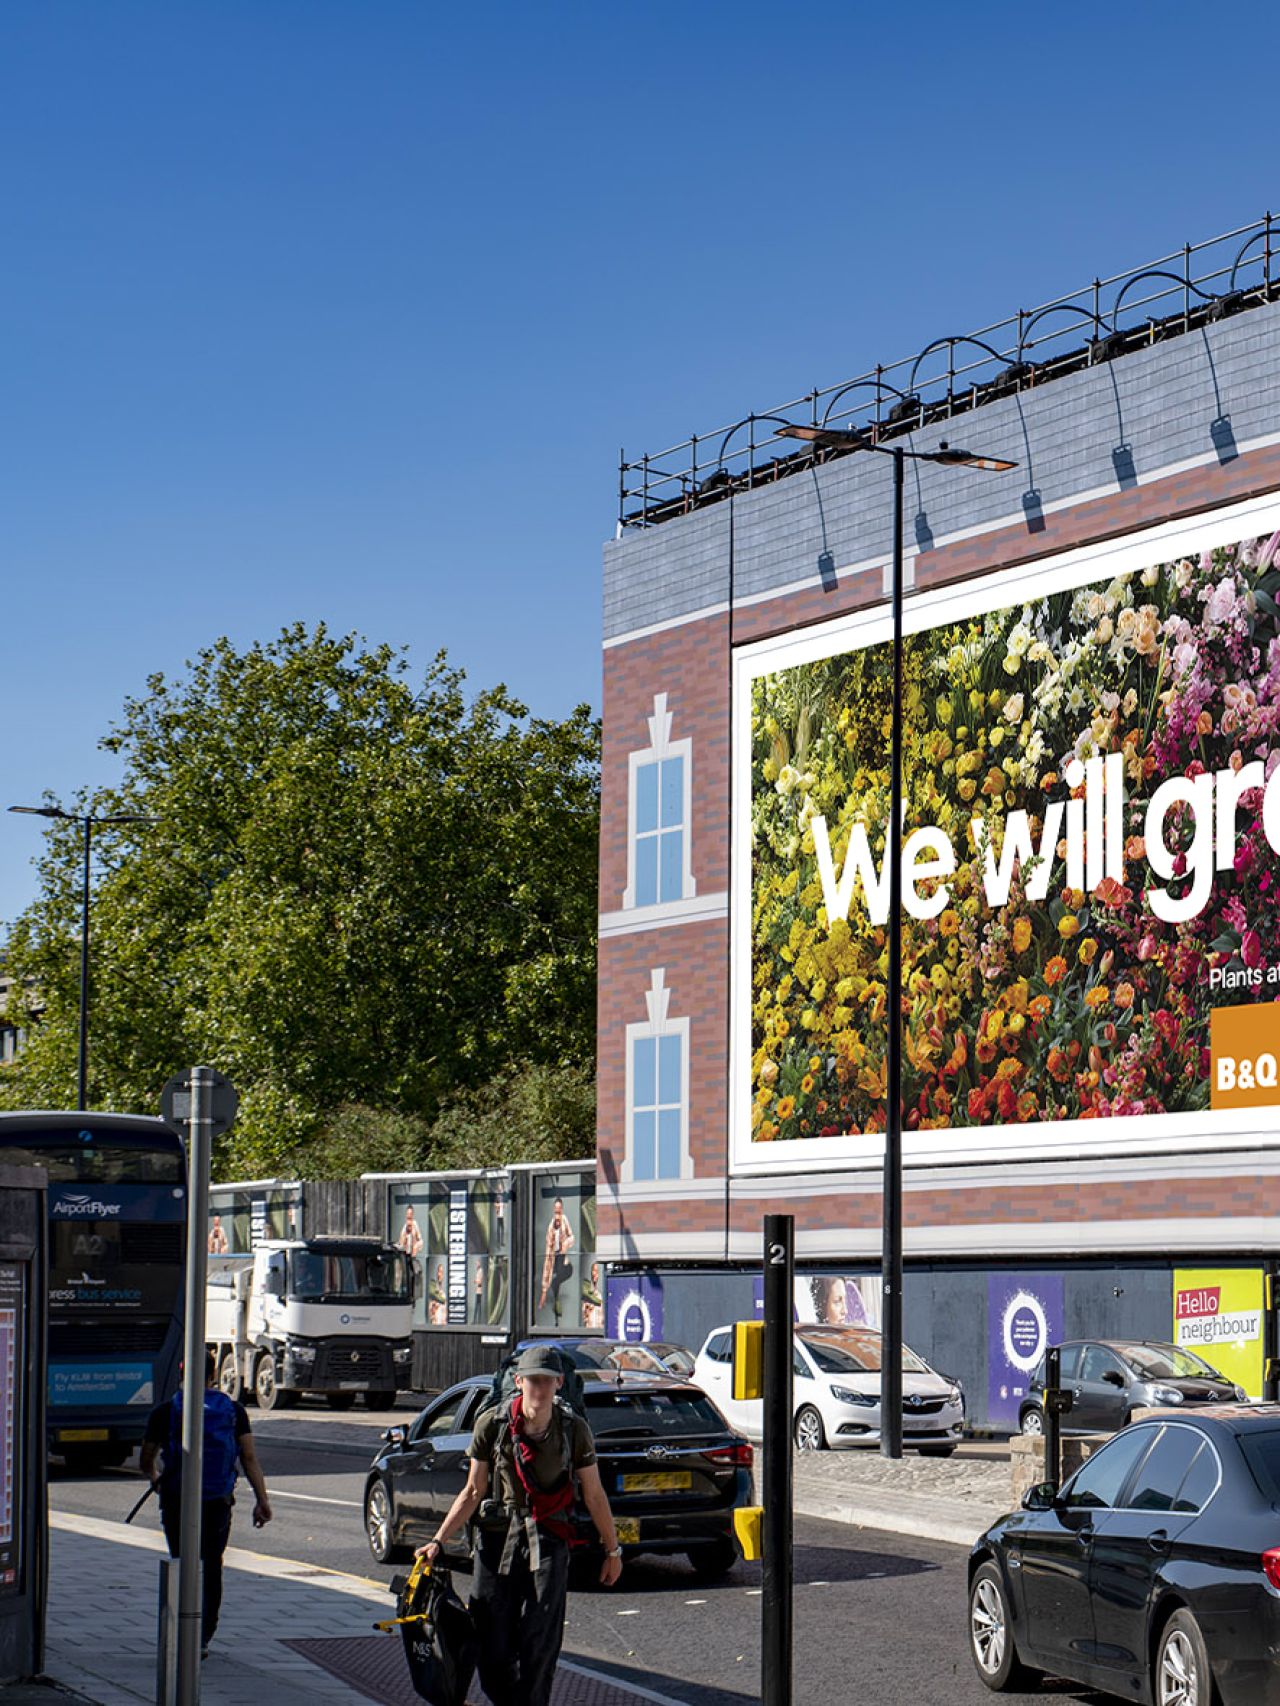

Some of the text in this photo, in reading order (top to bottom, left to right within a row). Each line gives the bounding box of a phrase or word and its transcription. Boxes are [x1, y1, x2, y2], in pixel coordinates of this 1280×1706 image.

[811, 798, 953, 928] We
[972, 752, 1124, 908] will
[1210, 967, 1263, 990] Plants
[1217, 1053, 1278, 1091] B&Q
[770, 1244, 785, 1265] 2
[884, 1284, 891, 1295] 8
[1178, 1291, 1218, 1314] Hello
[1181, 1316, 1258, 1343] neighbour
[1050, 1352, 1058, 1361] 4
